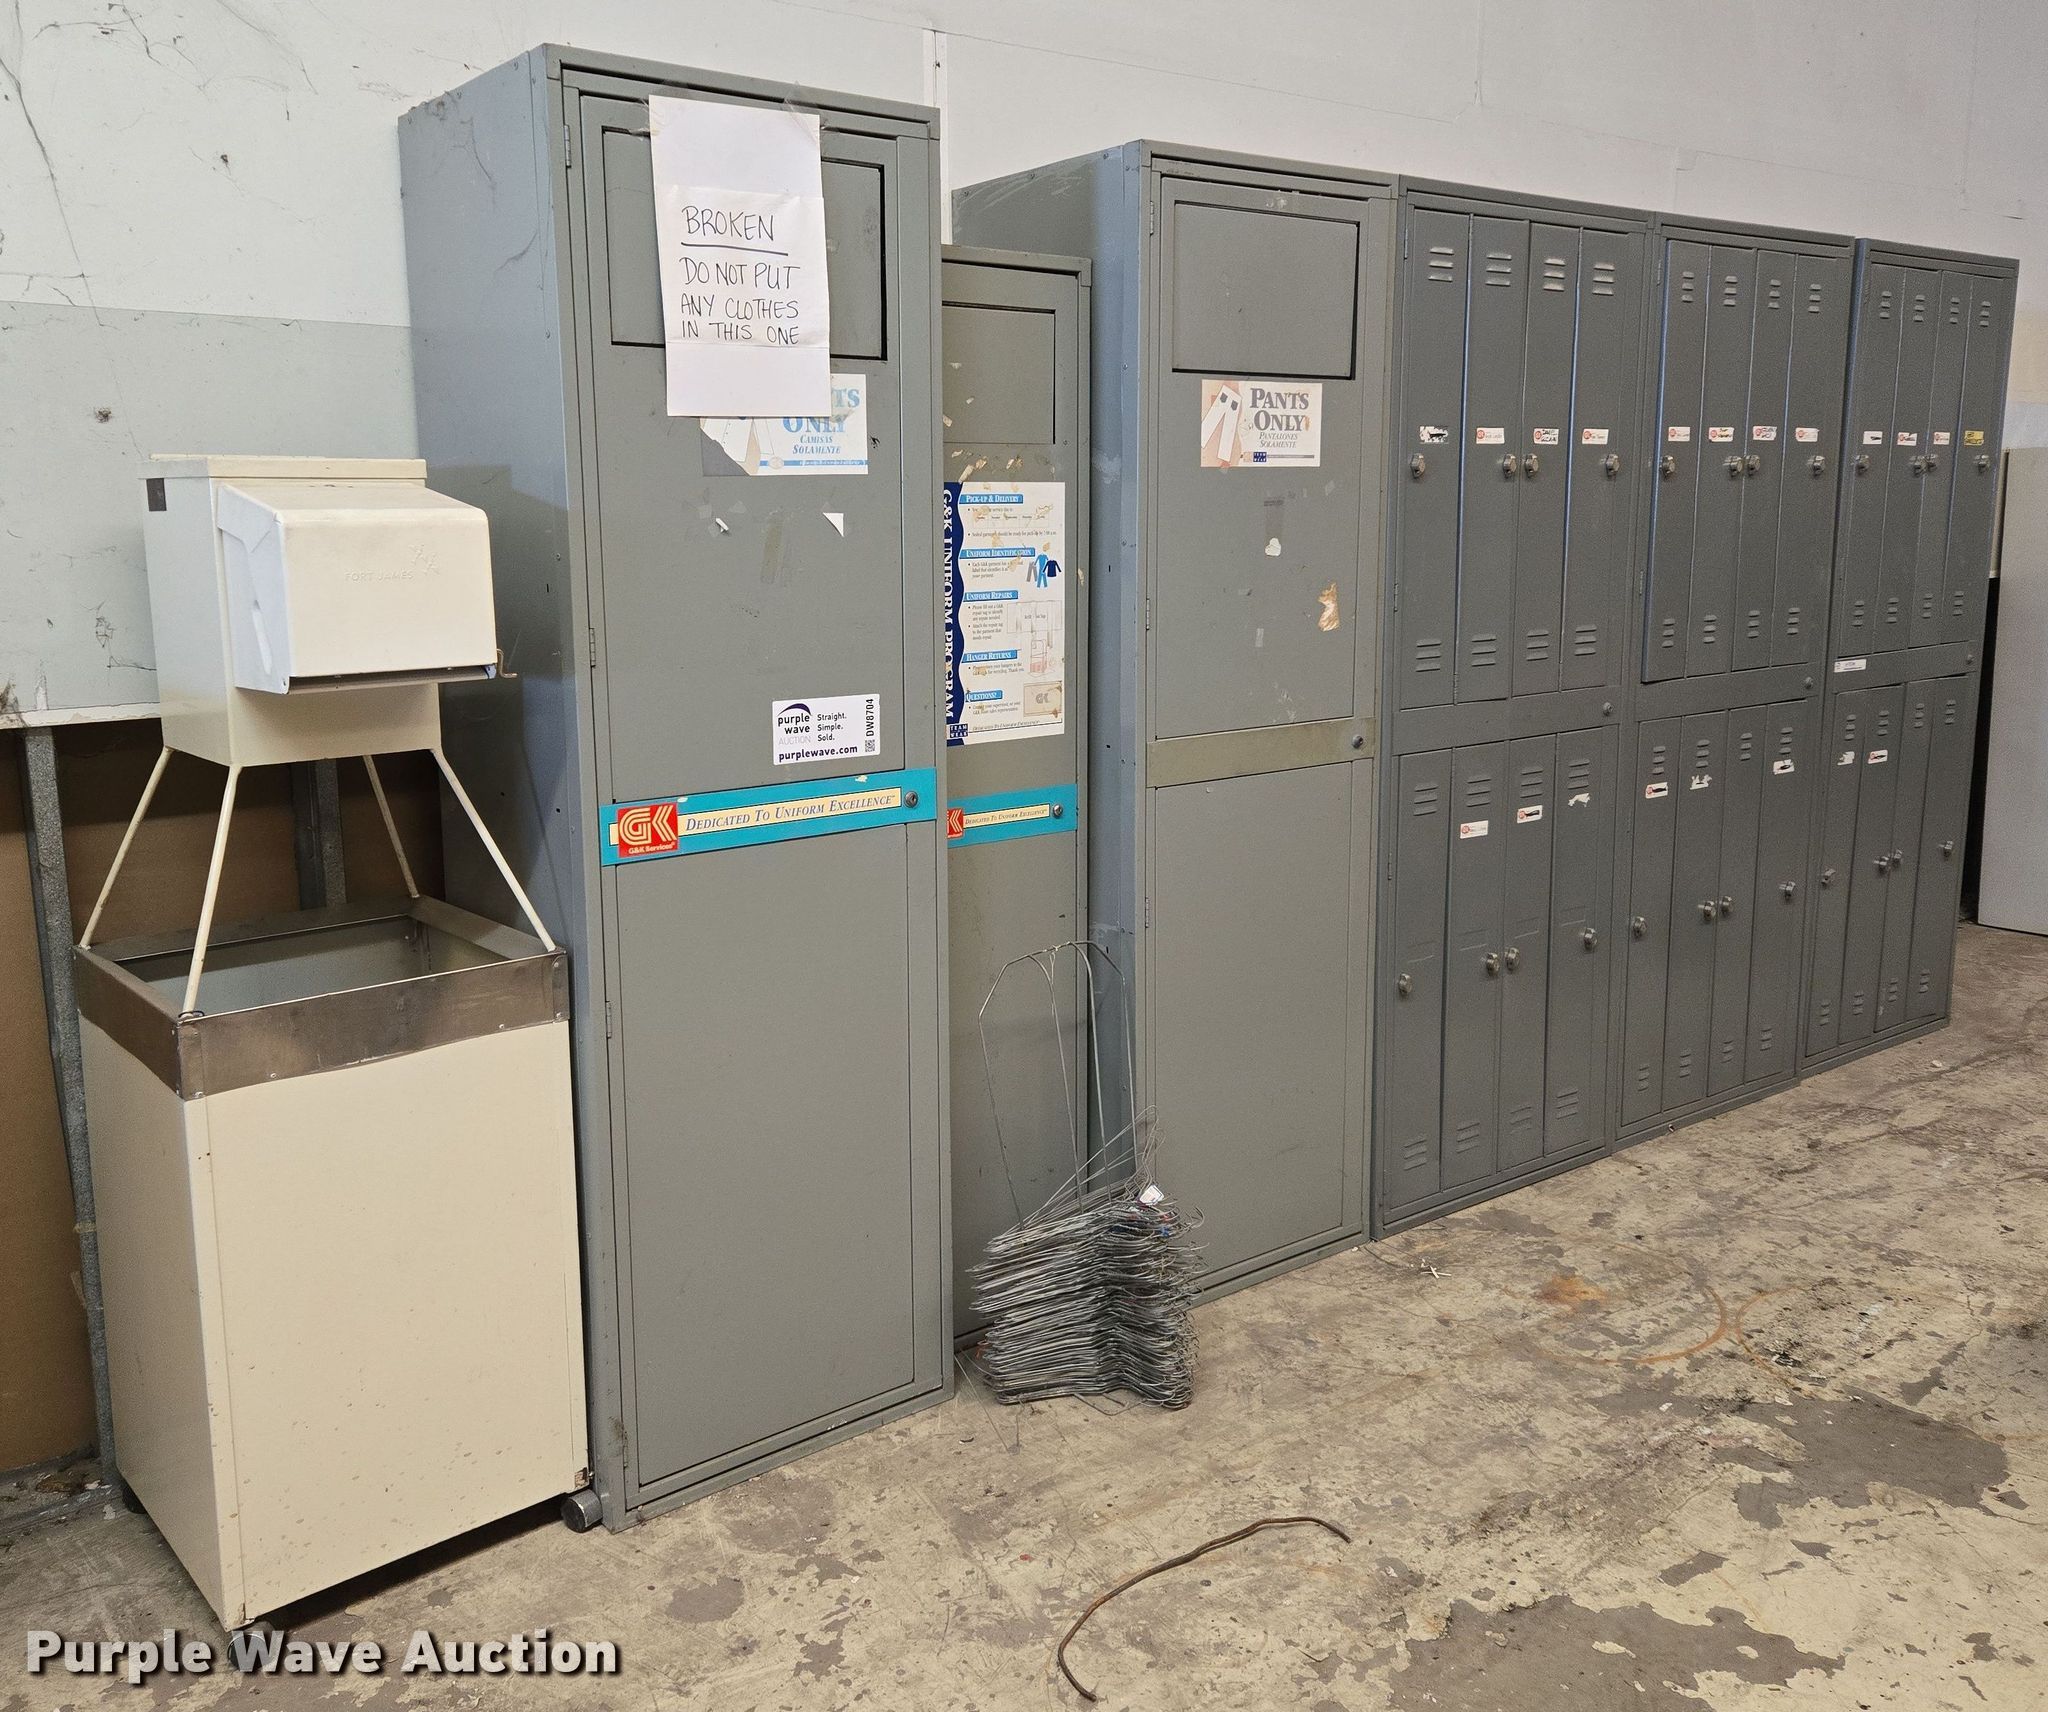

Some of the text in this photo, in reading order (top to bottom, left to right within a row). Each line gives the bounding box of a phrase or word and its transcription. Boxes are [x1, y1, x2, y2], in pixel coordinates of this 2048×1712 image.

[681, 205, 775, 241] BROKEN
[678, 256, 801, 290] DO NOT PUT
[681, 292, 799, 320] ANY CLOTHES
[682, 319, 799, 345] IN THIS ONE
[1249, 387, 1310, 410] PANTS
[1253, 409, 1306, 432] ONLY
[777, 713, 810, 727] purple
[817, 712, 847, 722] Straight.
[817, 723, 844, 732] Simple.
[865, 698, 875, 737] DW8704
[778, 735, 812, 746] AUCTION
[784, 725, 811, 735] wave
[817, 733, 835, 742] Sold.
[778, 745, 858, 763] purplewave.com
[685, 813, 751, 832] DEDICATED
[775, 803, 825, 819] UNIFORM
